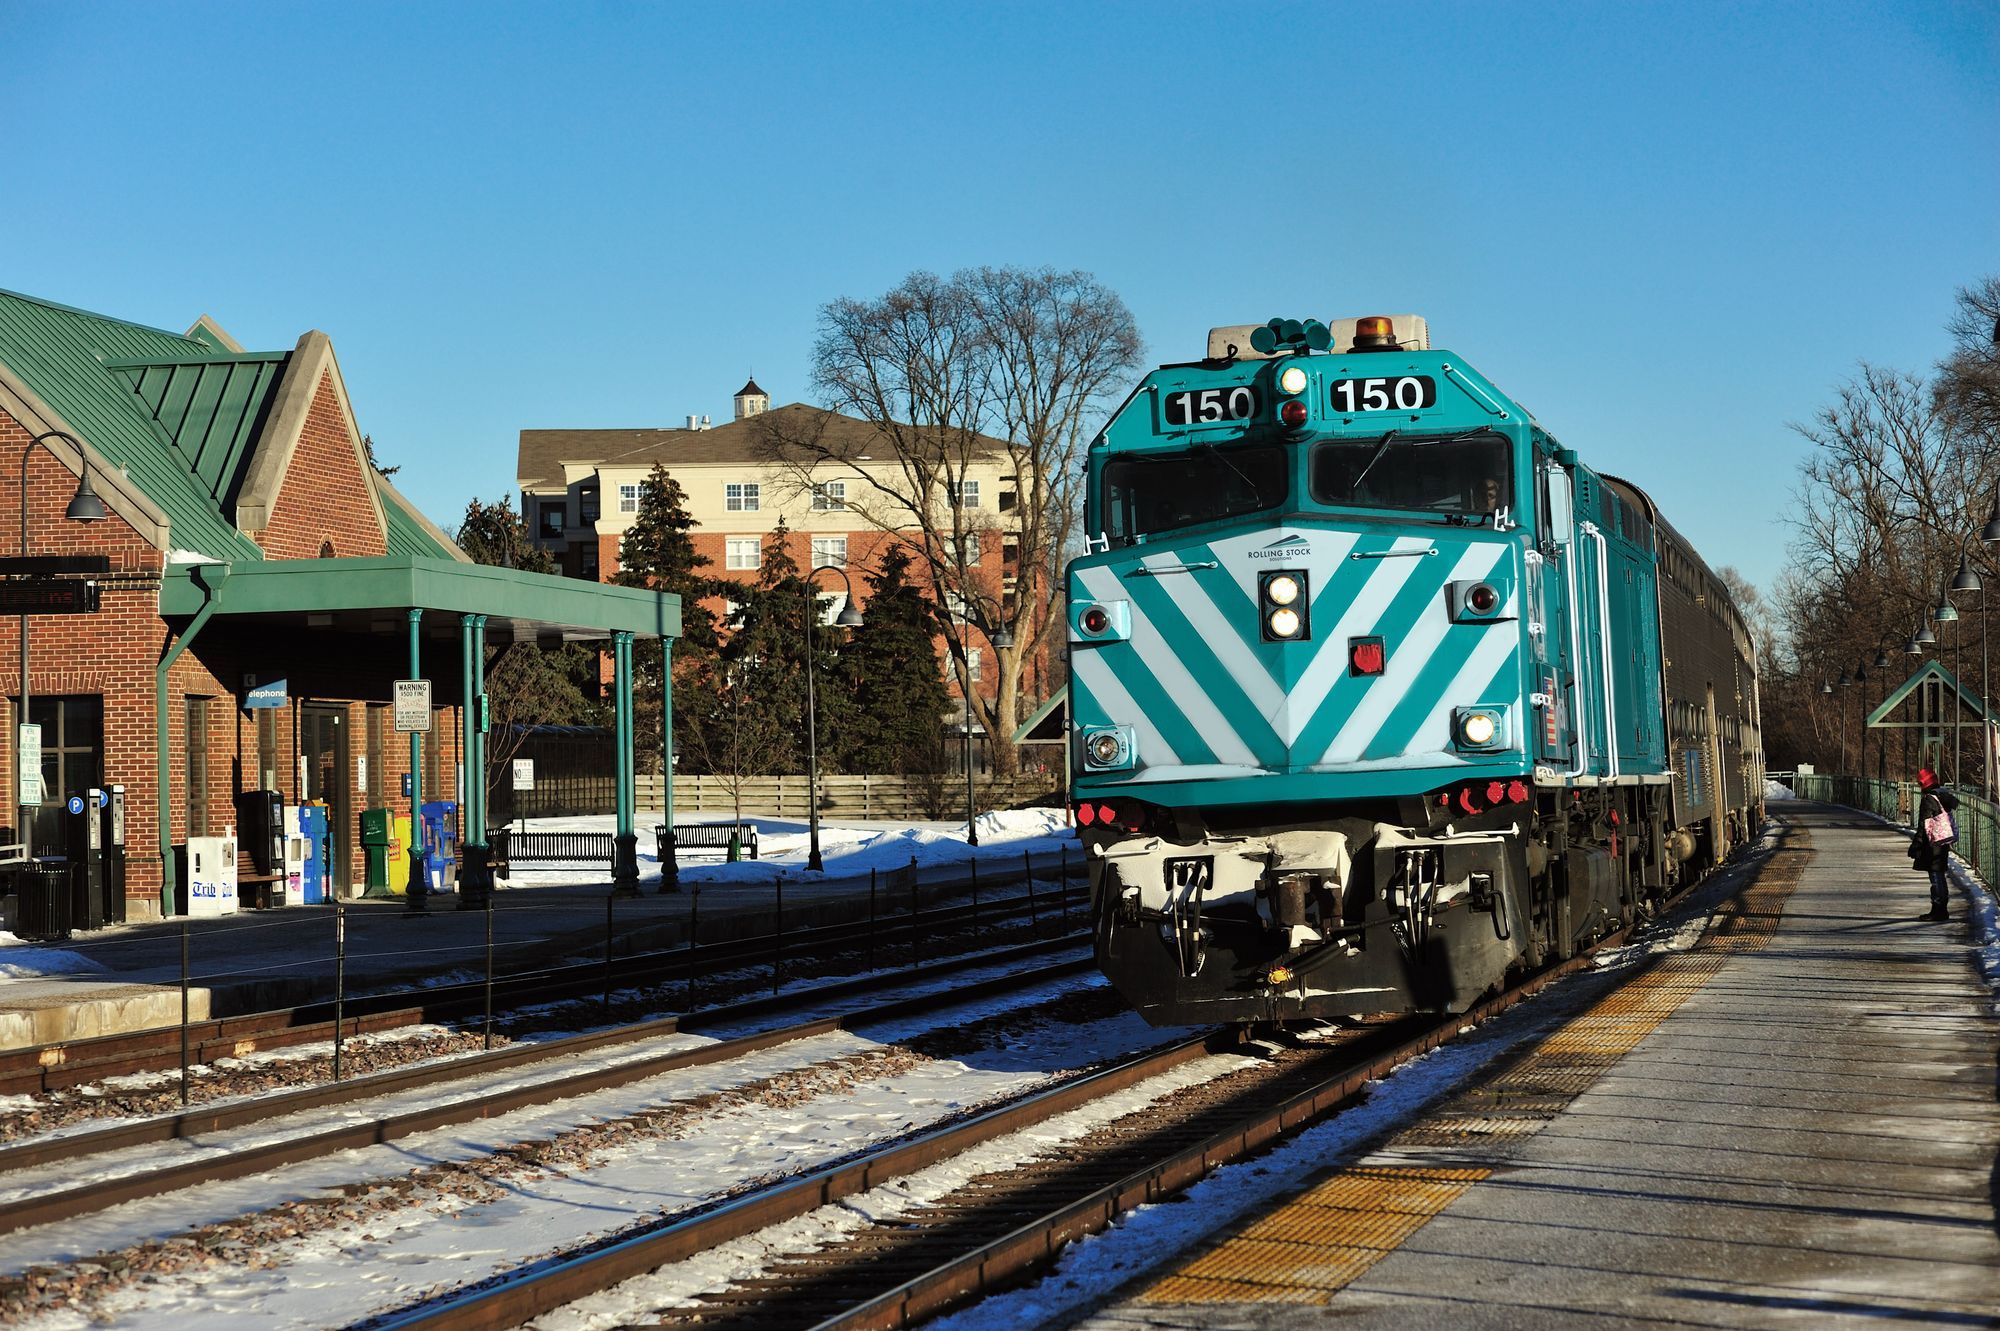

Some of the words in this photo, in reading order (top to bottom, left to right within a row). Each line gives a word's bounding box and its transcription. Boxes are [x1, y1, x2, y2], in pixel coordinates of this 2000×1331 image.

[1337, 376, 1424, 412] 150
[1176, 386, 1256, 426] 150
[1248, 550, 1284, 558] ROLLING
[243, 688, 285, 699] Telephone
[73, 799, 80, 811] P
[193, 881, 216, 897] Trib
